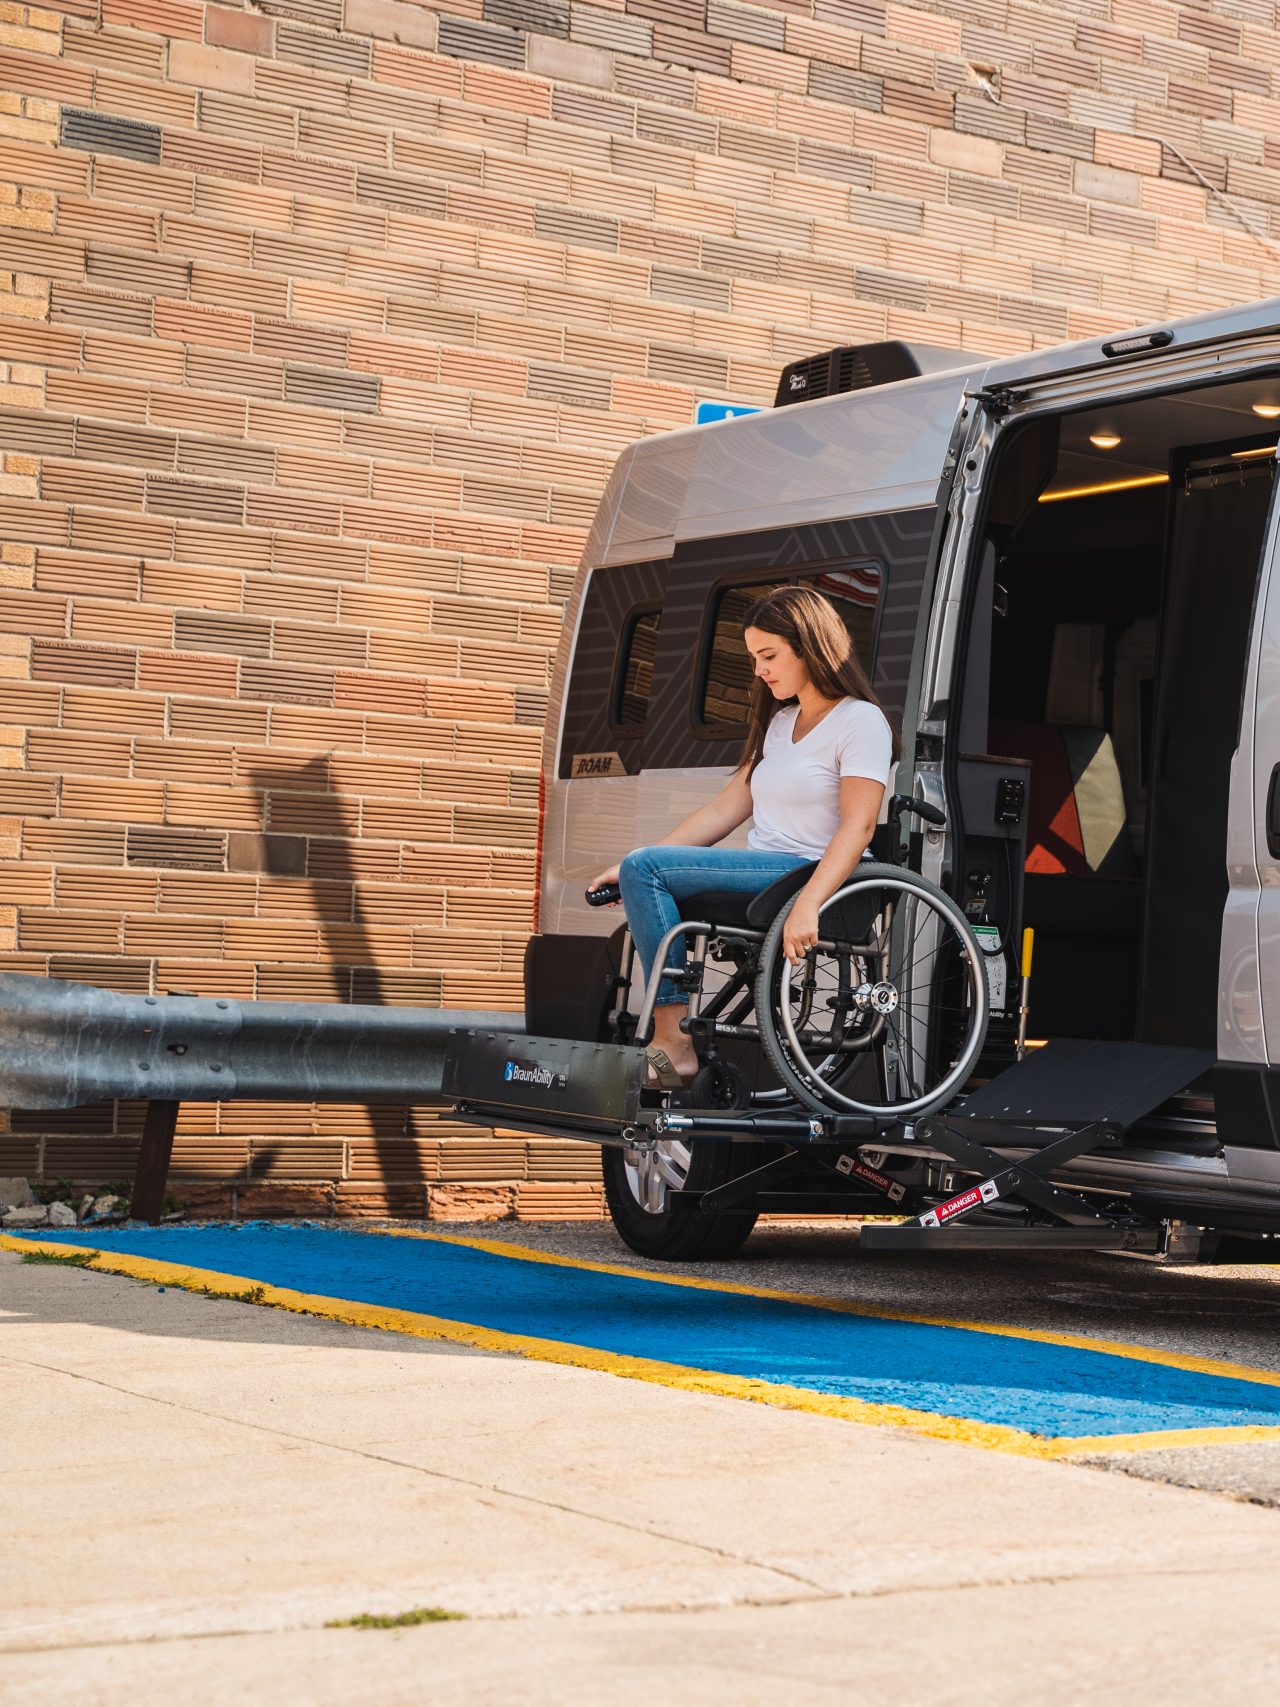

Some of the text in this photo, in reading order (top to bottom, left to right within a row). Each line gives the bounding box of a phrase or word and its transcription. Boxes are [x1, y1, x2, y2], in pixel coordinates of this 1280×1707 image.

[577, 756, 613, 775] ROAM
[513, 1065, 555, 1088] BraunAbility
[862, 1168, 889, 1187] DANGER
[947, 1192, 978, 1212] DANGER
